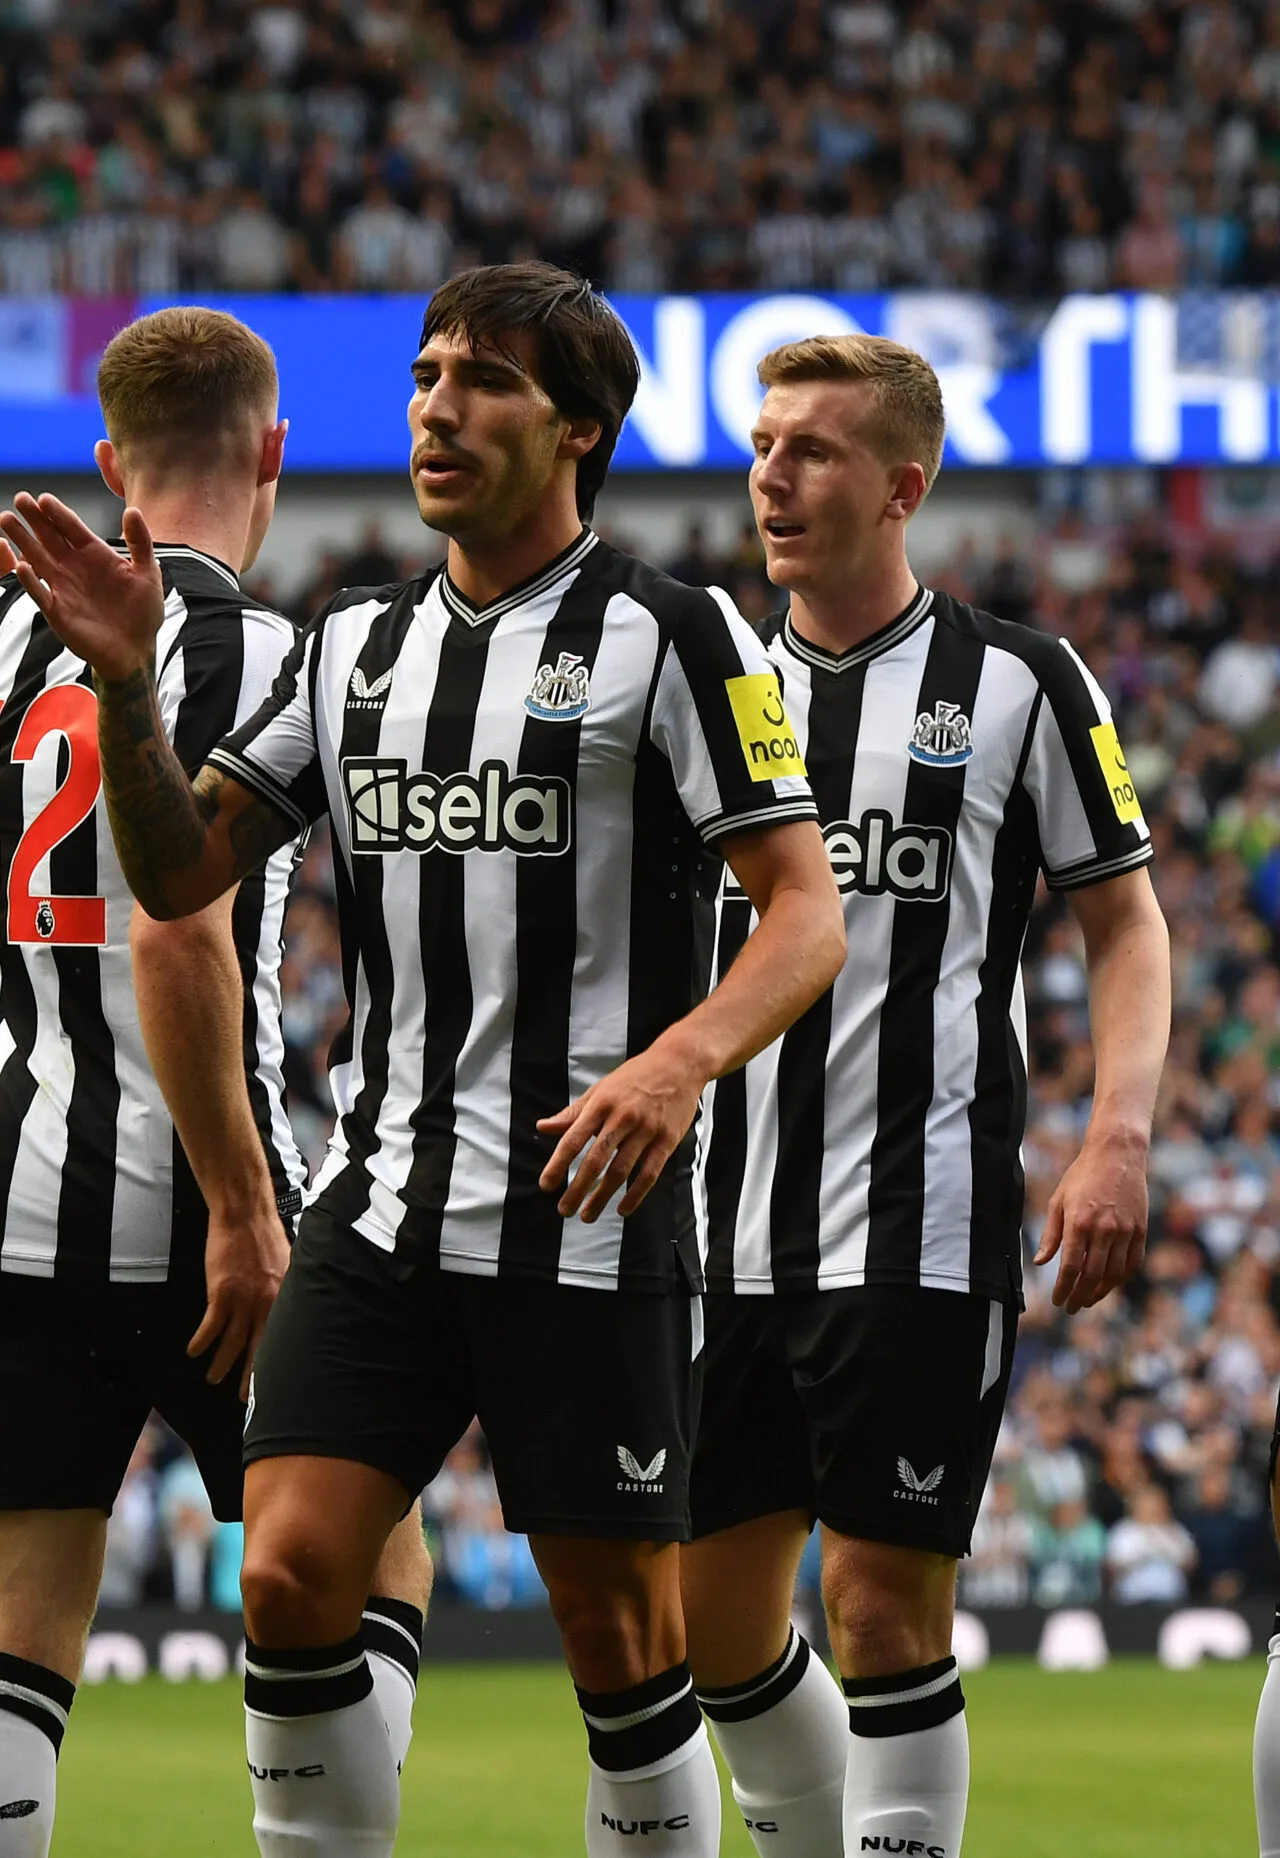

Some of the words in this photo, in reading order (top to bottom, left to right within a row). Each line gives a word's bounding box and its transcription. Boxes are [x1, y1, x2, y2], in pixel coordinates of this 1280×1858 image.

[606, 294, 1280, 466] NORTH
[346, 700, 385, 710] CASTORE
[749, 738, 801, 764] noo
[404, 769, 558, 844] sela
[1113, 783, 1135, 807] no
[823, 818, 940, 891] ela
[616, 1481, 664, 1494] CASTORE
[893, 1490, 939, 1506] CASTORE
[601, 1812, 690, 1836] NUFC
